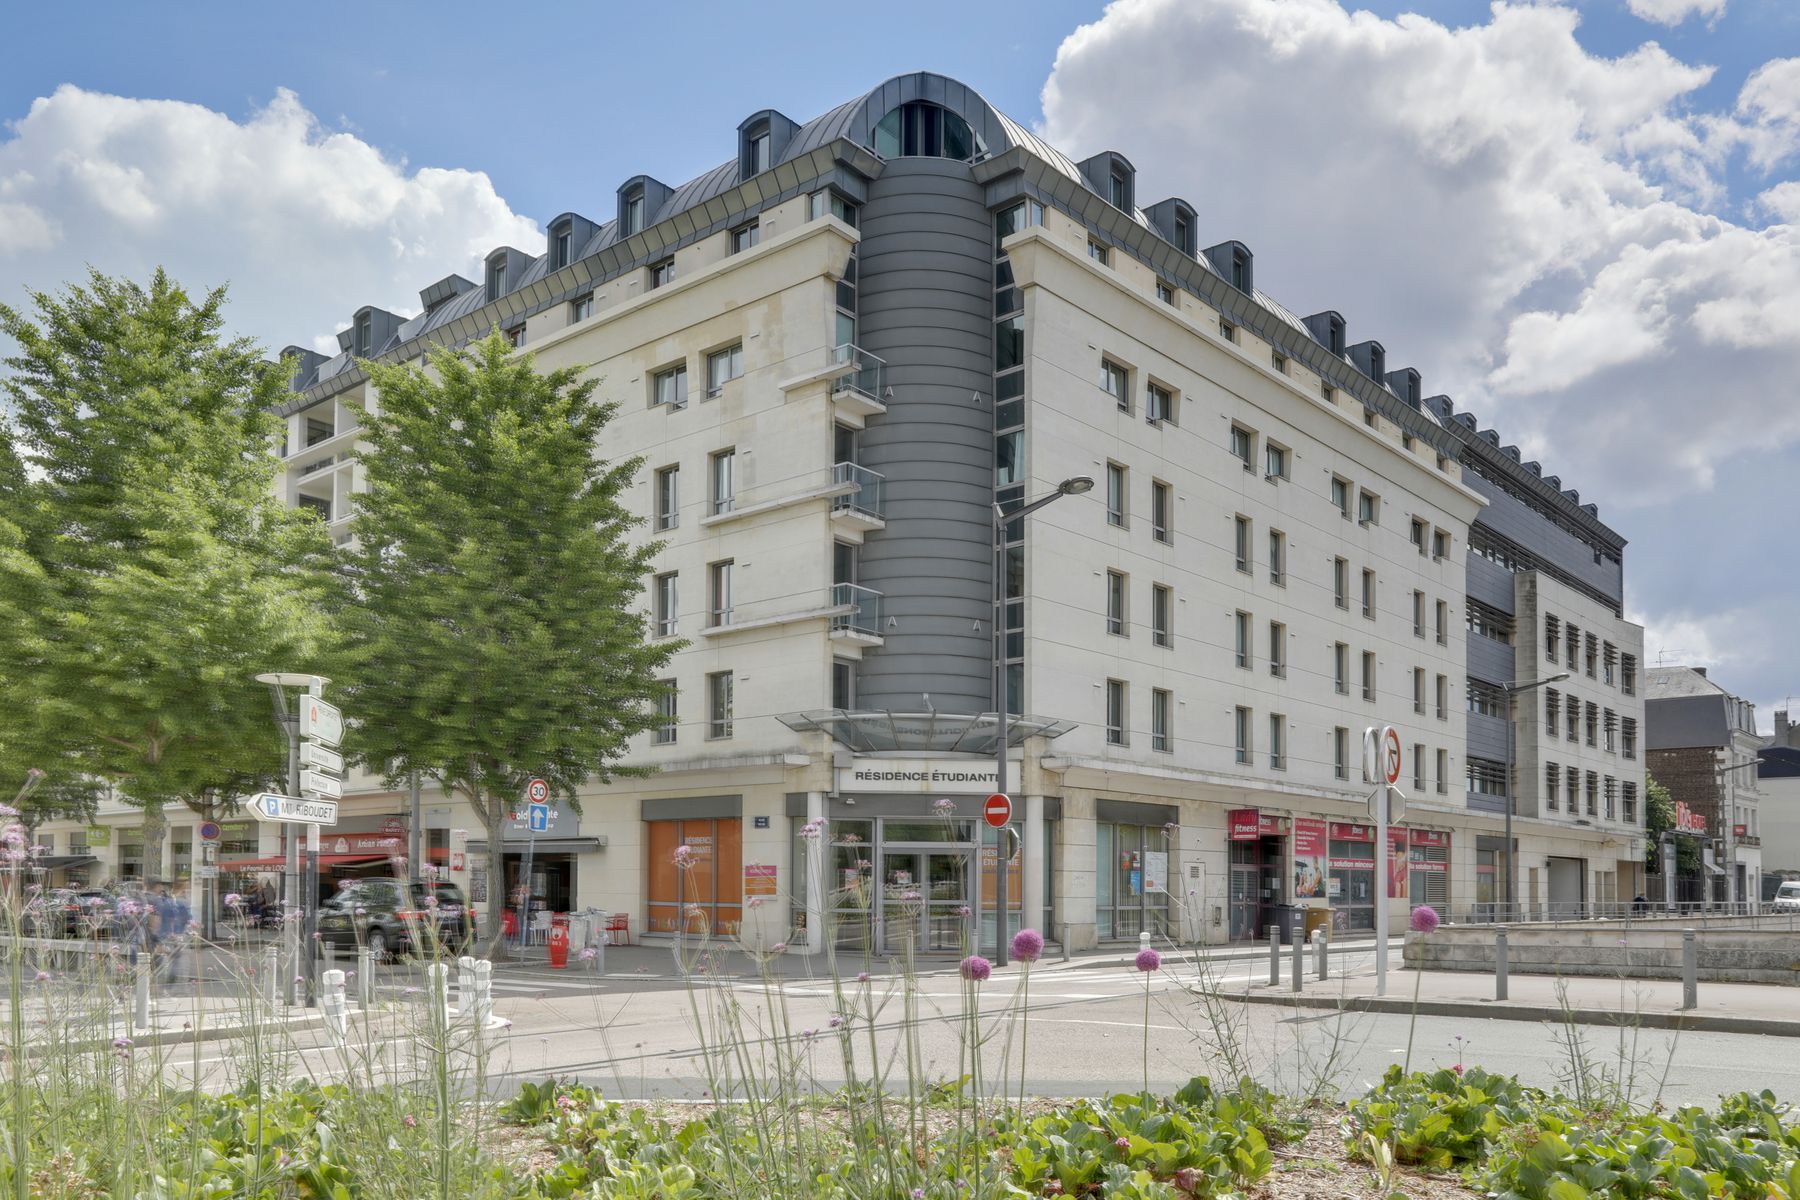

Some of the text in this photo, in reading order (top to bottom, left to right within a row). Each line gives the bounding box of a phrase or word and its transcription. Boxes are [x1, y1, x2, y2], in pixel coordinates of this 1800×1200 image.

[855, 768, 929, 781] RÉSIDENCE
[533, 786, 545, 797] 30
[296, 801, 334, 818] RIBOUDET
[1234, 823, 1257, 834] fitness
